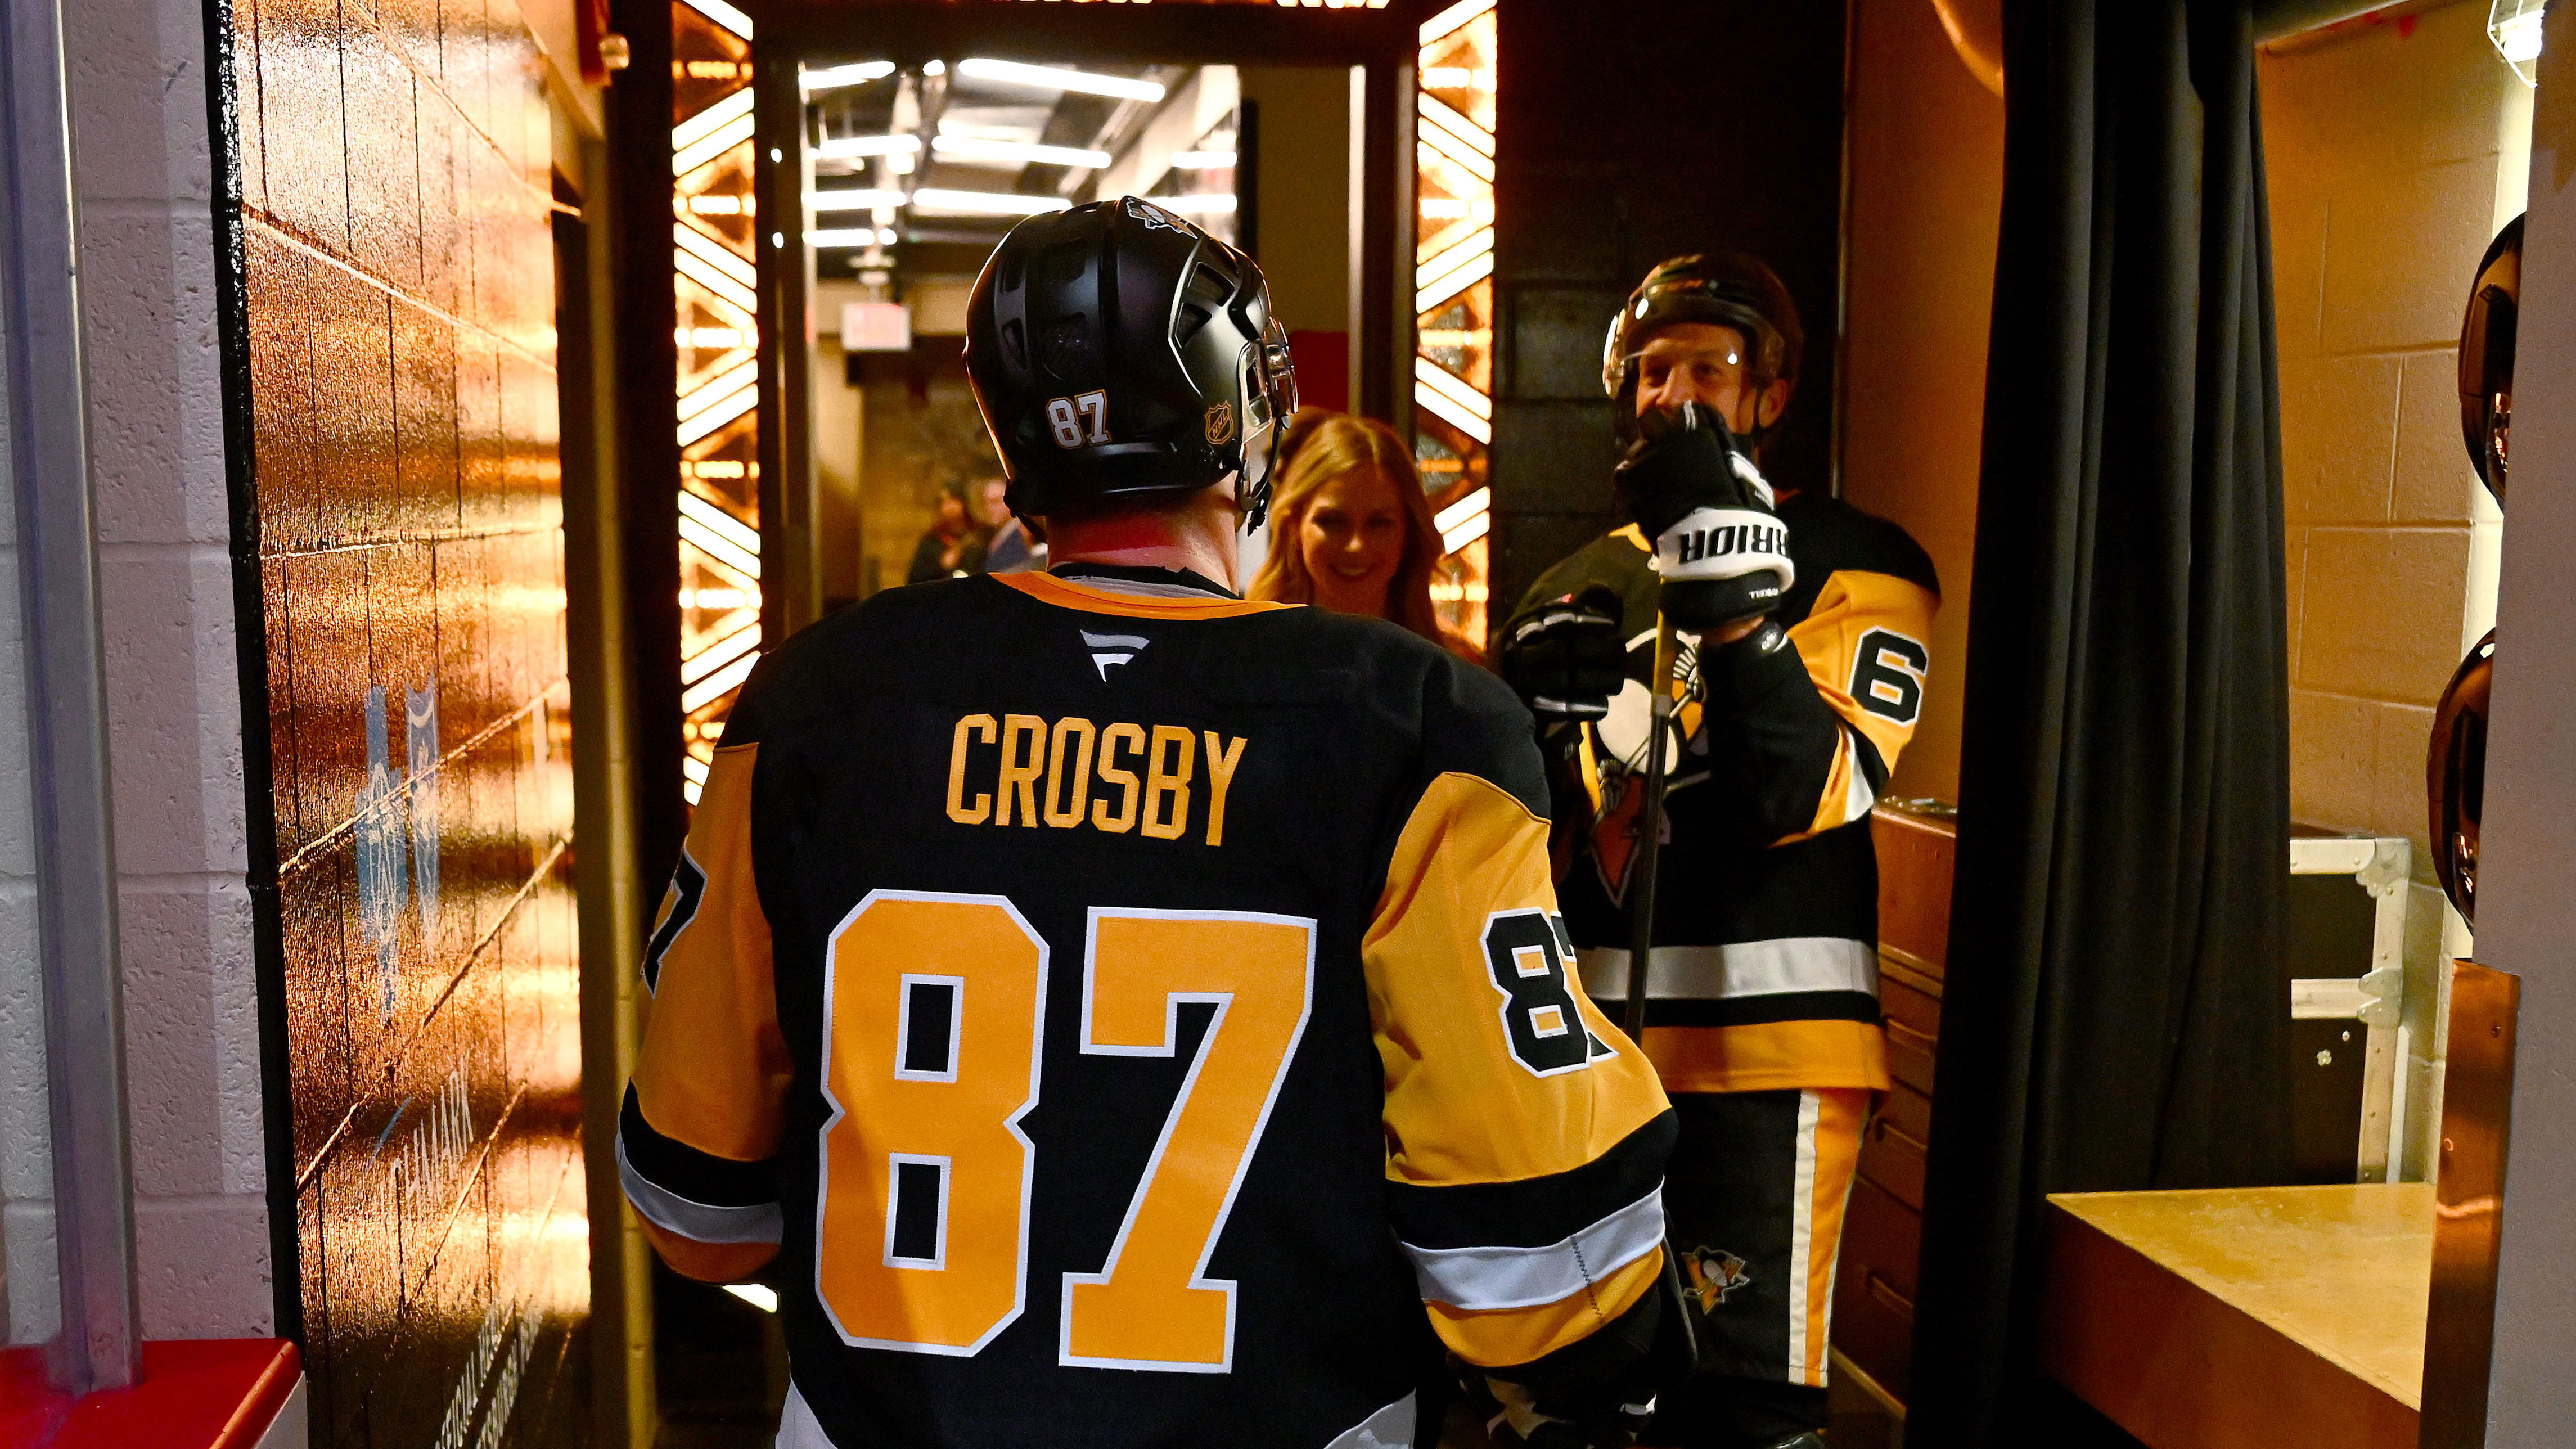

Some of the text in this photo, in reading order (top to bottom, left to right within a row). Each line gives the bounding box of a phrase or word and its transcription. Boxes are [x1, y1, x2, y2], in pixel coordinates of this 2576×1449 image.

[1046, 389, 1113, 449] 87
[1212, 412, 1228, 438] NHL
[945, 713, 1248, 847] CROSBY
[814, 889, 1318, 1374] 87
